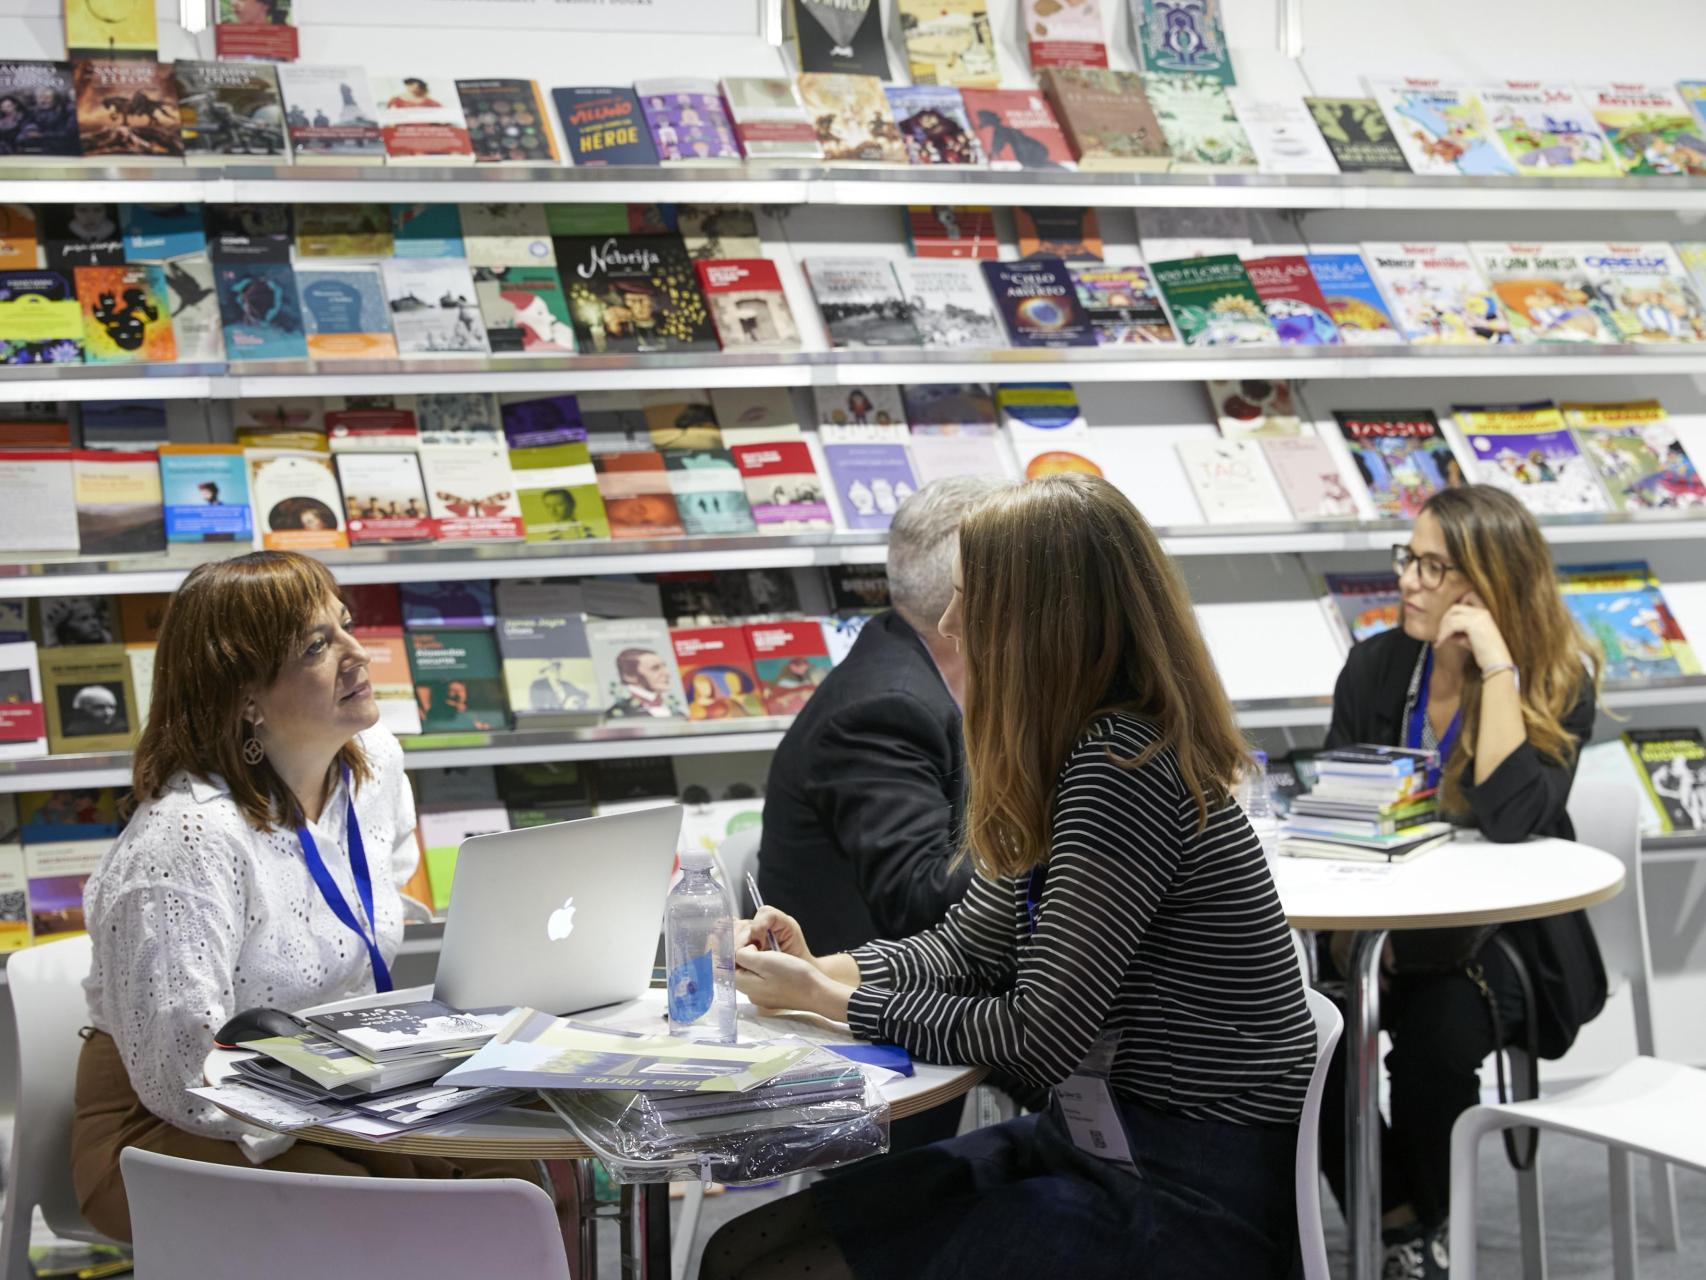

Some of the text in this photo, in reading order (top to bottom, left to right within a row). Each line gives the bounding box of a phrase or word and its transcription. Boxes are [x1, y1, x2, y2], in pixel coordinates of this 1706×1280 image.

[569, 101, 632, 125] VILLANO
[577, 238, 661, 279] Nebrija
[1010, 272, 1056, 285] CIELO
[1006, 285, 1066, 298] ABIERTO
[581, 1076, 704, 1087] dica libros
